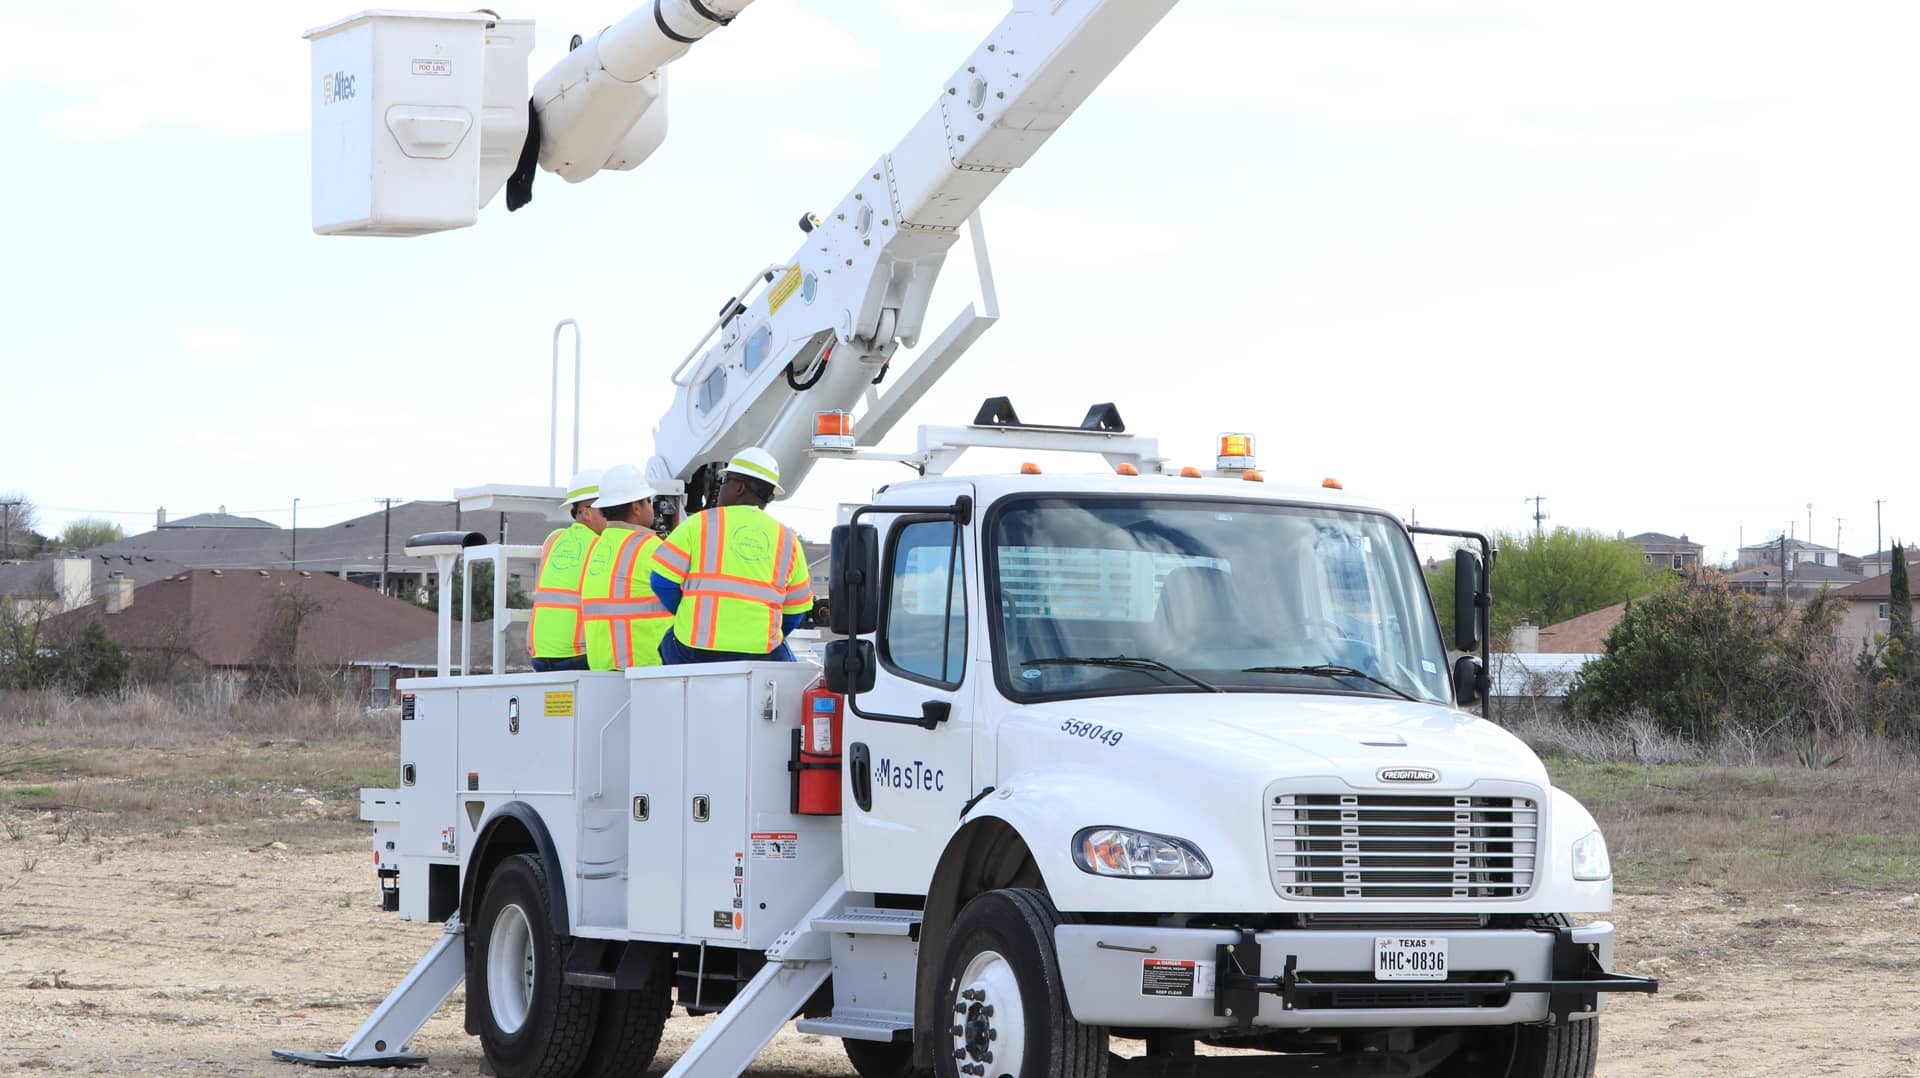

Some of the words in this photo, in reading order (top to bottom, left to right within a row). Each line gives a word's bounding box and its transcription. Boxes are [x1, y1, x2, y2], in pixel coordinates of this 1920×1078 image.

[333, 71, 356, 104] Altec
[1061, 718, 1123, 747] 558049
[880, 758, 944, 792] MasTec
[1384, 771, 1435, 780] FREIGHTLINER
[1399, 939, 1427, 948] TEXAS
